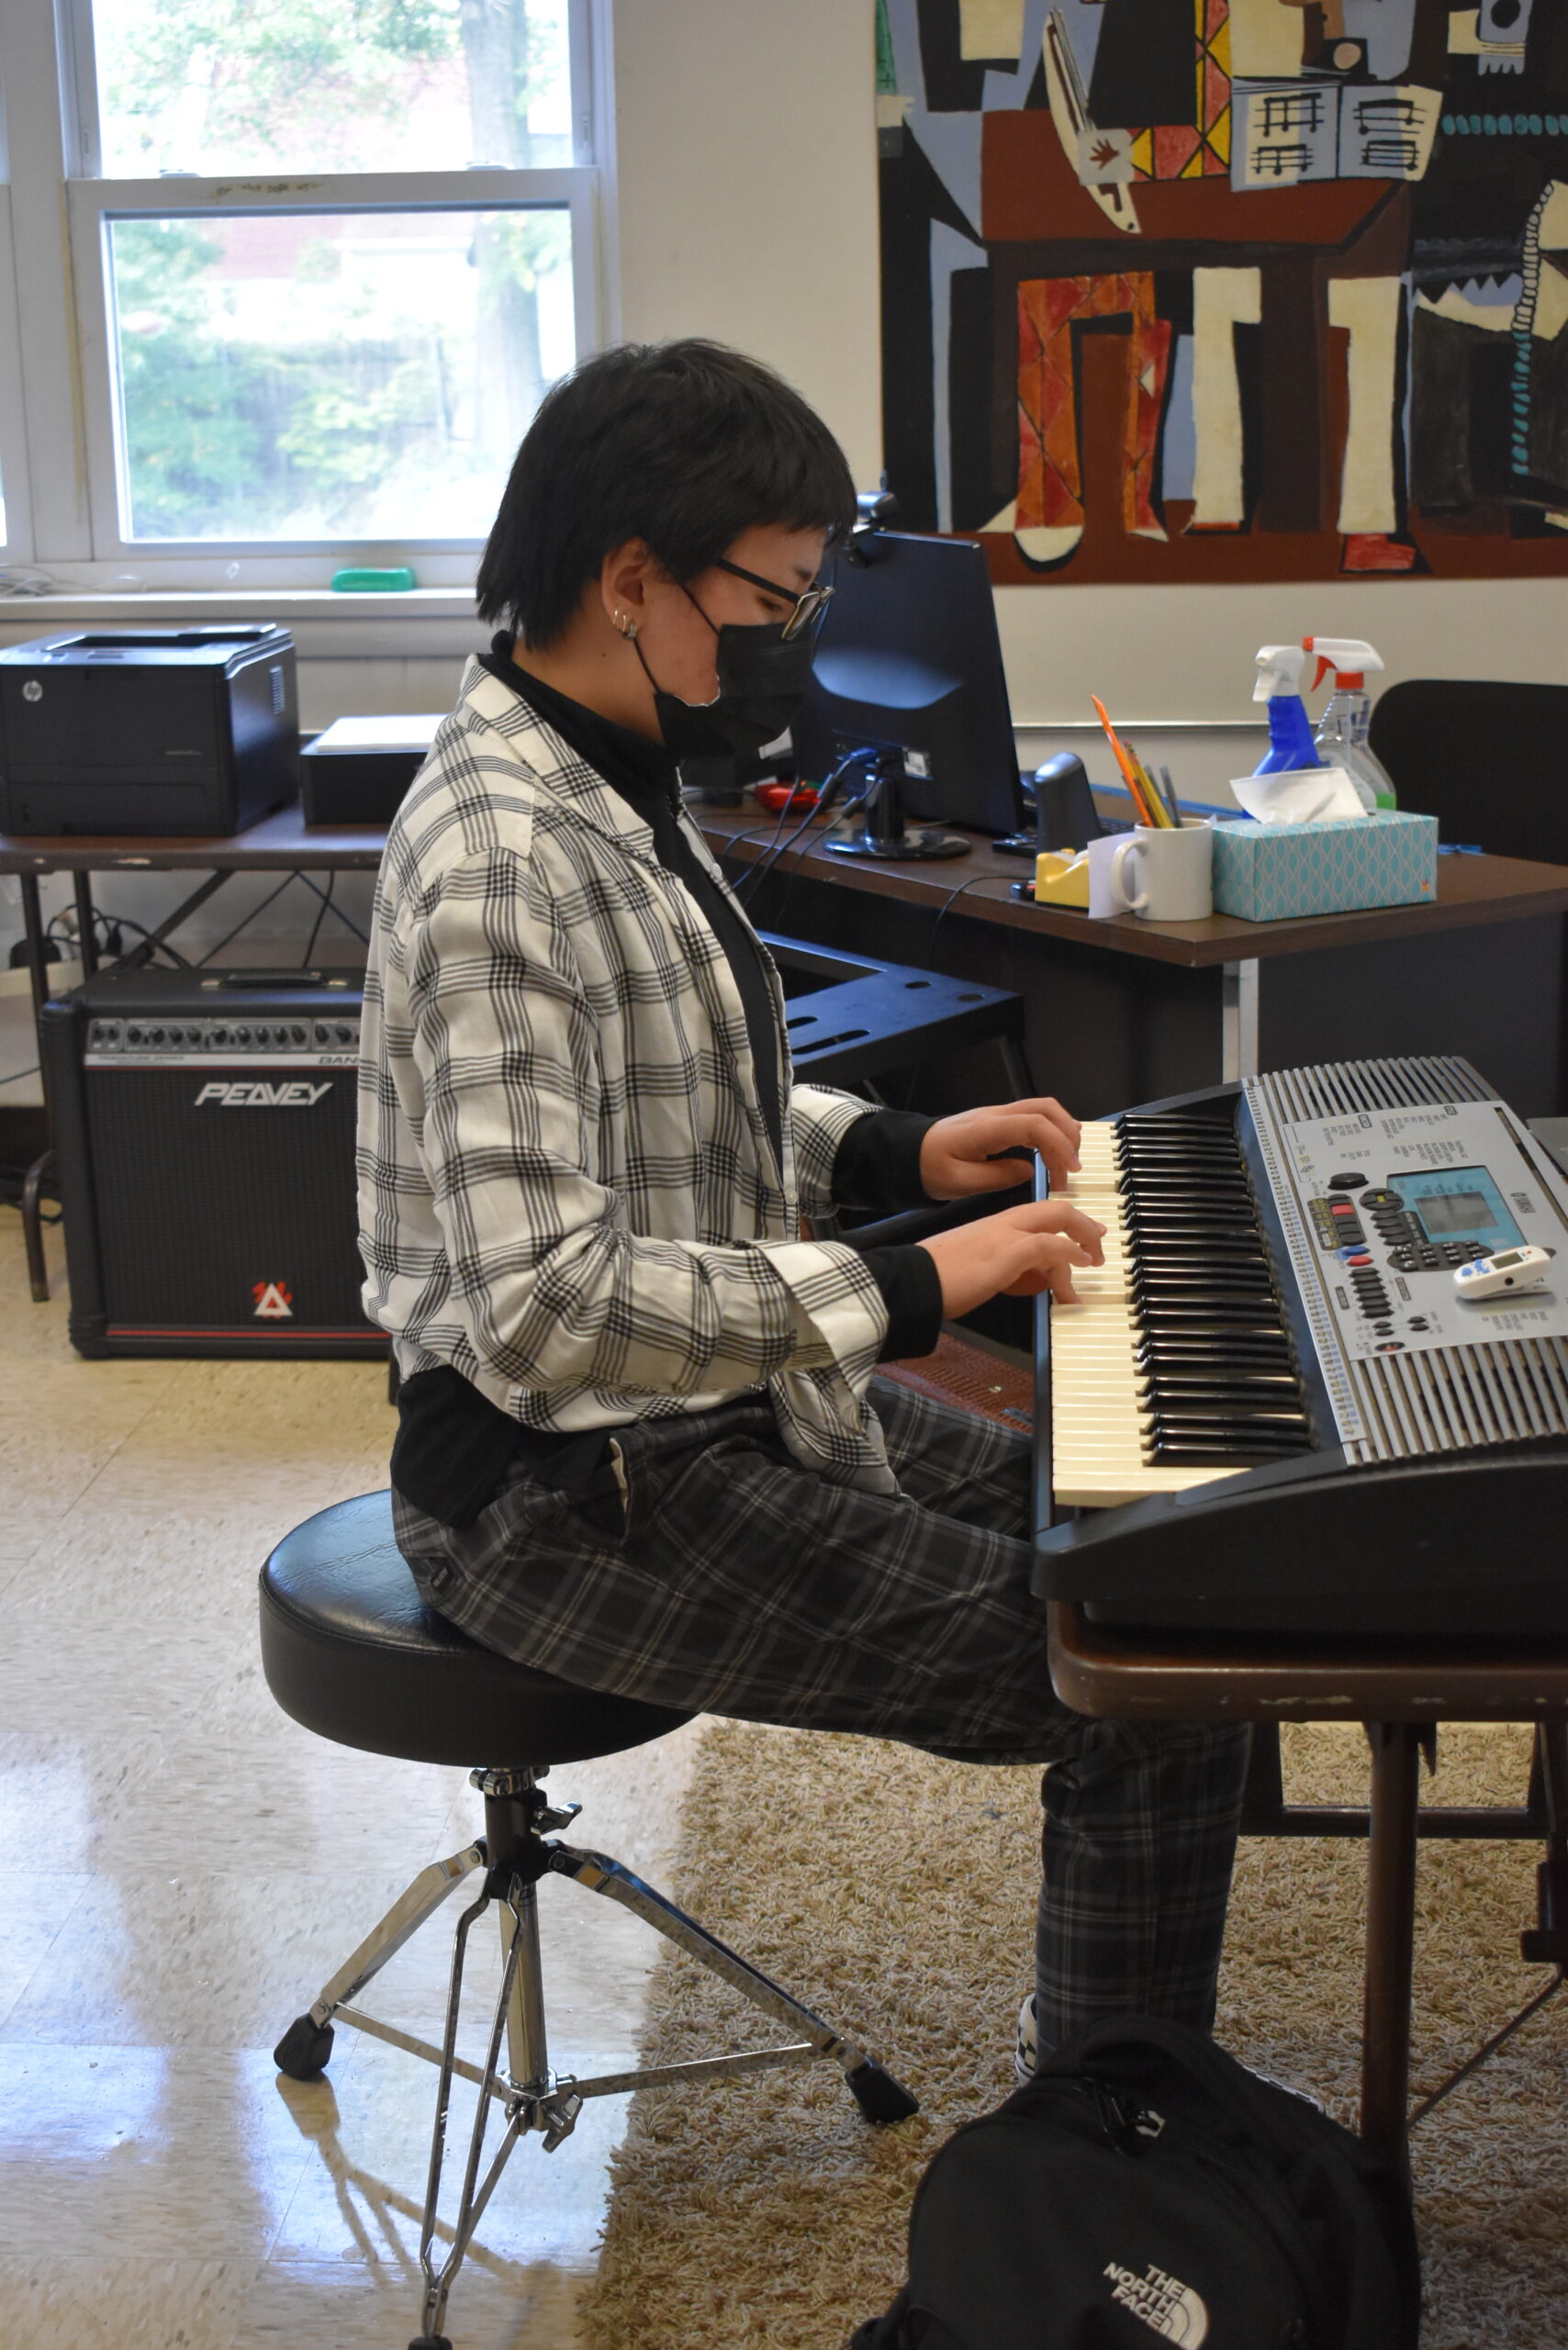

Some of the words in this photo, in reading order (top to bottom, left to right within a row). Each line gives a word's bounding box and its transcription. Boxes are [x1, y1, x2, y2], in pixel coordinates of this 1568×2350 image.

[195, 1082, 333, 1106] PEAVEY
[1103, 2262, 1176, 2313] NORTH
[1145, 2264, 1186, 2300] THE
[1111, 2285, 1167, 2329] FACE
